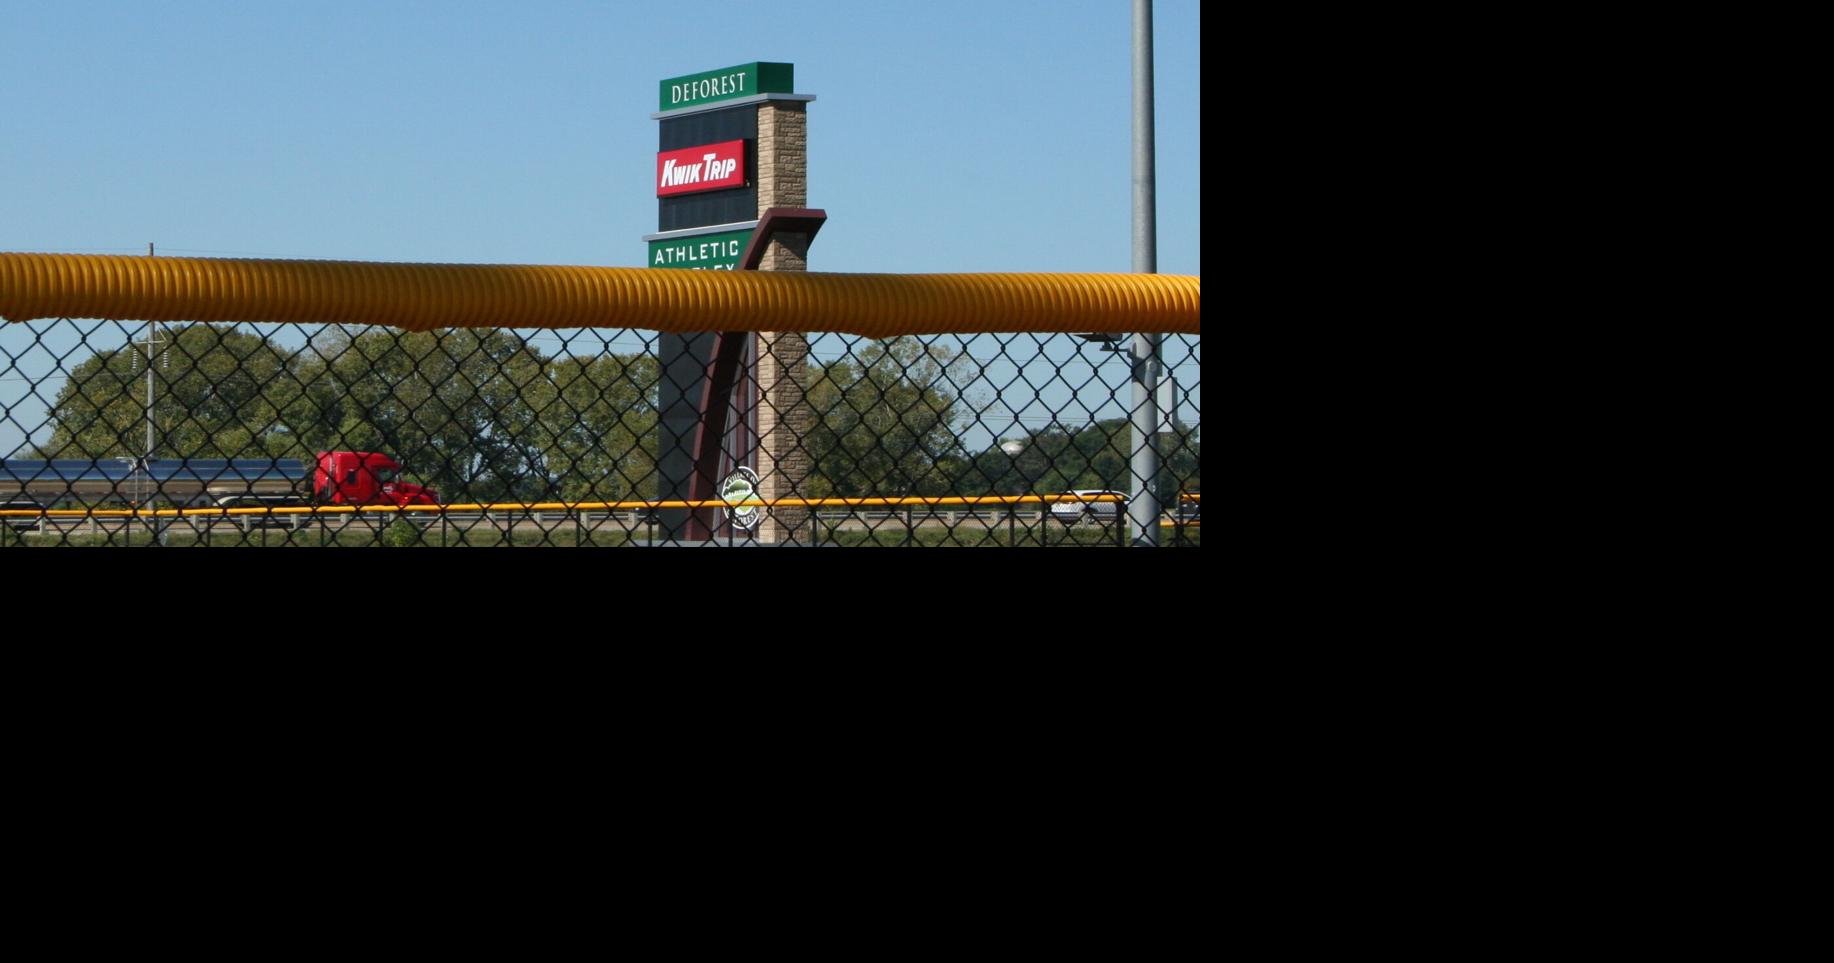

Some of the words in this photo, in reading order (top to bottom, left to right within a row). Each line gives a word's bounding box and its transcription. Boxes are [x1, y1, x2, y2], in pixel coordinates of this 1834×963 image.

[672, 72, 746, 104] DEFOREST
[660, 159, 703, 188] KWIK
[702, 153, 737, 182] TRIP
[654, 240, 739, 265] ATHLETIC
